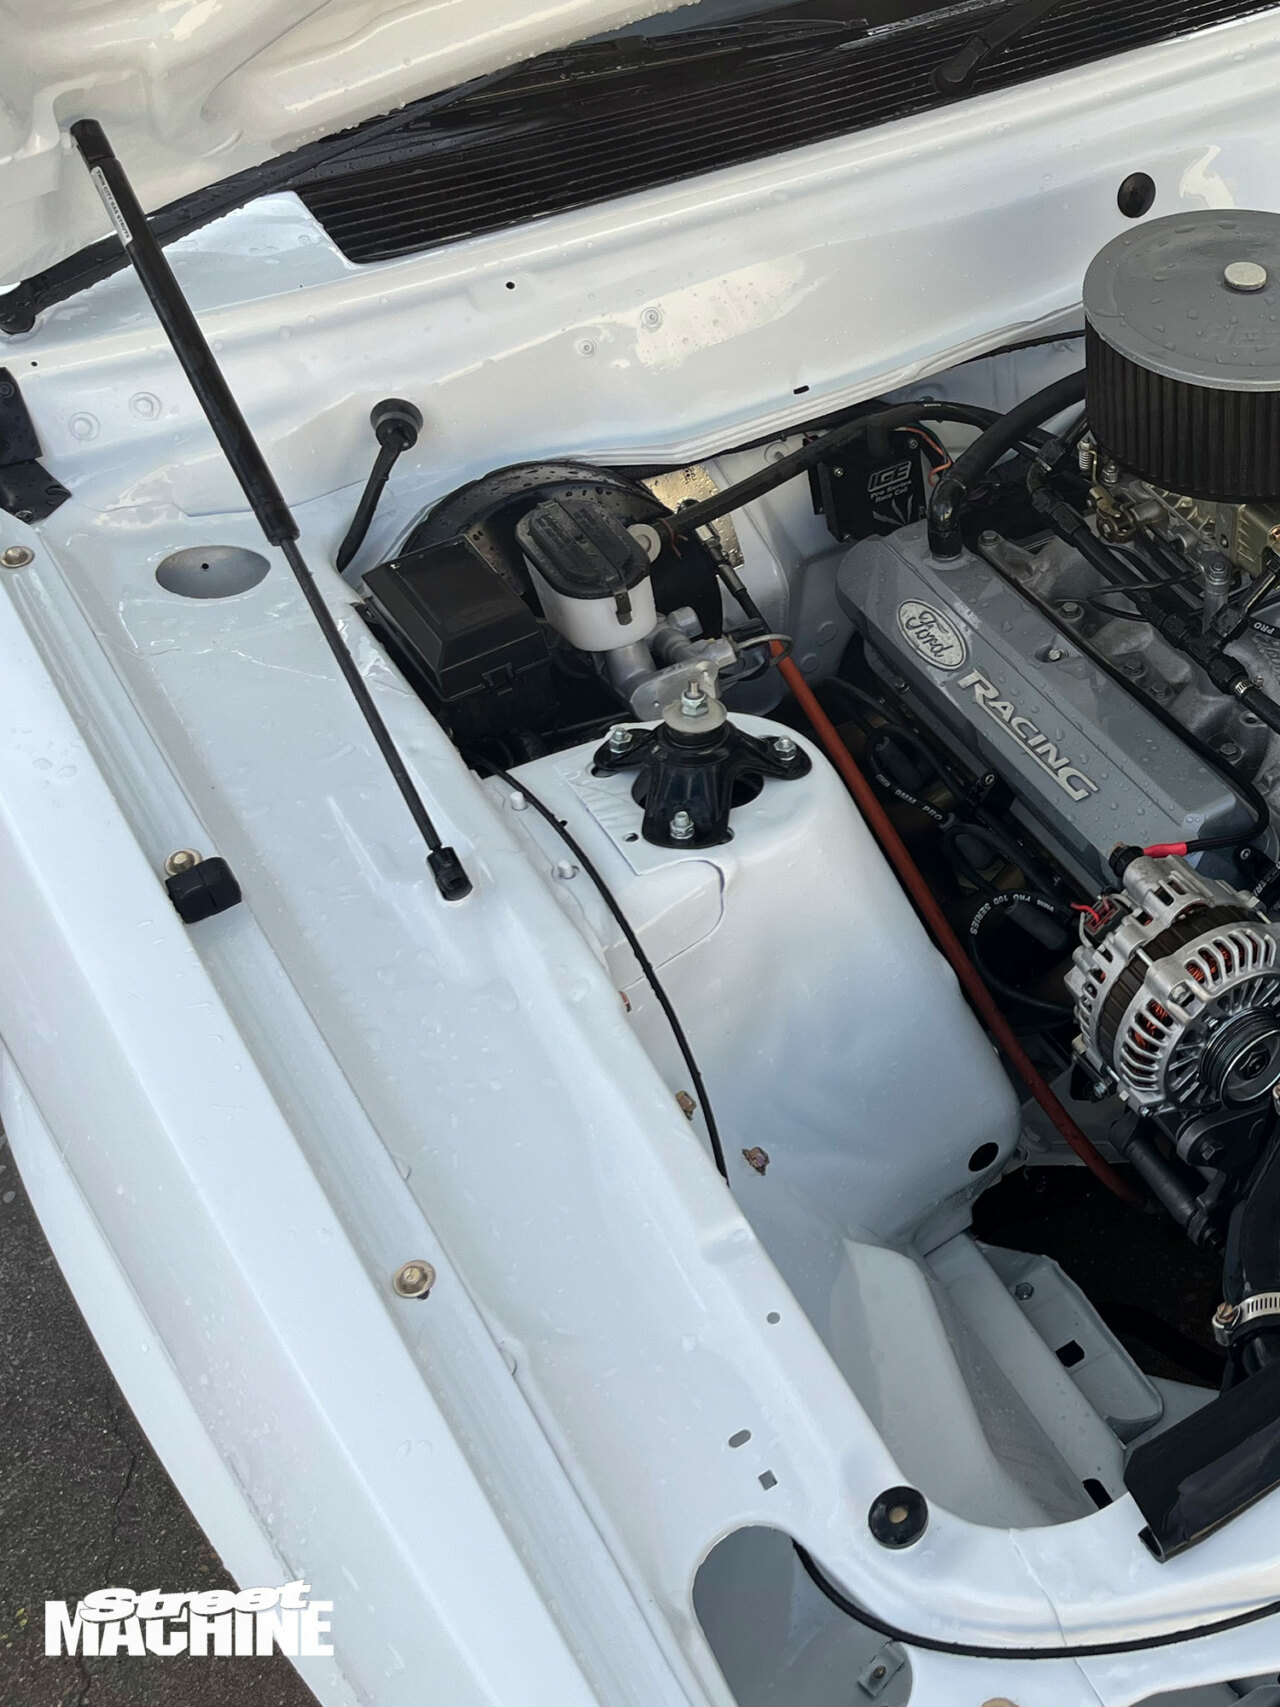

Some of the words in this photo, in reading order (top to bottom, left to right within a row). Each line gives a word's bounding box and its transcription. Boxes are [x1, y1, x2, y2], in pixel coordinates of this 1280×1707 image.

[97, 169, 106, 186] TWIN
[103, 186, 113, 200] CITY
[110, 201, 119, 215] GAS
[116, 214, 130, 239] STRUTS
[905, 610, 954, 658] Ford
[1253, 621, 1276, 635] PRO
[956, 667, 1100, 803] RACING
[894, 789, 917, 805] 9MM
[921, 805, 943, 821] PRO
[993, 894, 1009, 905] 100
[1012, 893, 1031, 902] PRO
[969, 902, 992, 935] SERIES
